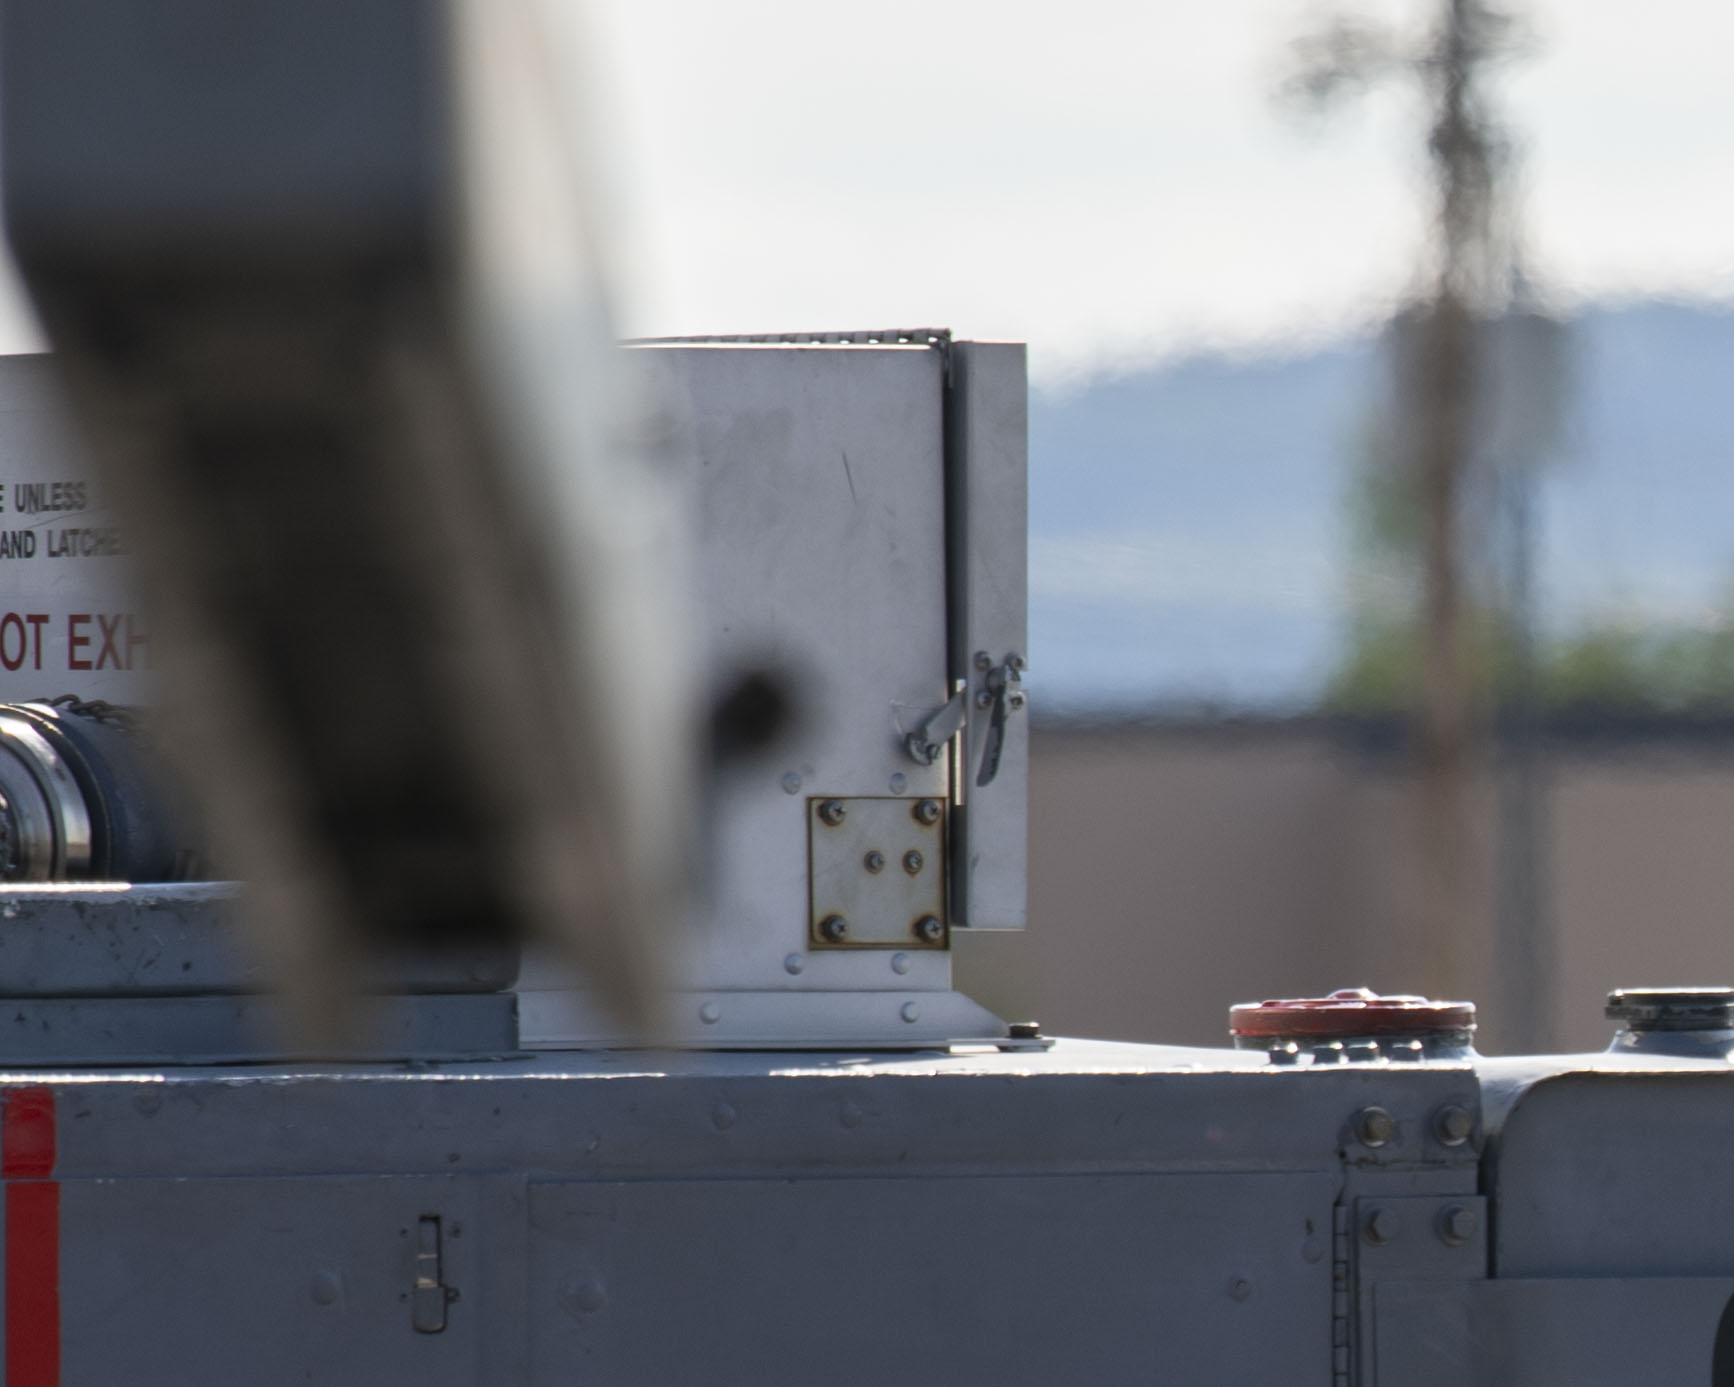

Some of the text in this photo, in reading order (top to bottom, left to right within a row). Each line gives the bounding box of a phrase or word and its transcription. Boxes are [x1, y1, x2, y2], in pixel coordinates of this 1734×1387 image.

[14, 481, 87, 513] UNLESS
[0, 527, 130, 559] AND LATCHE
